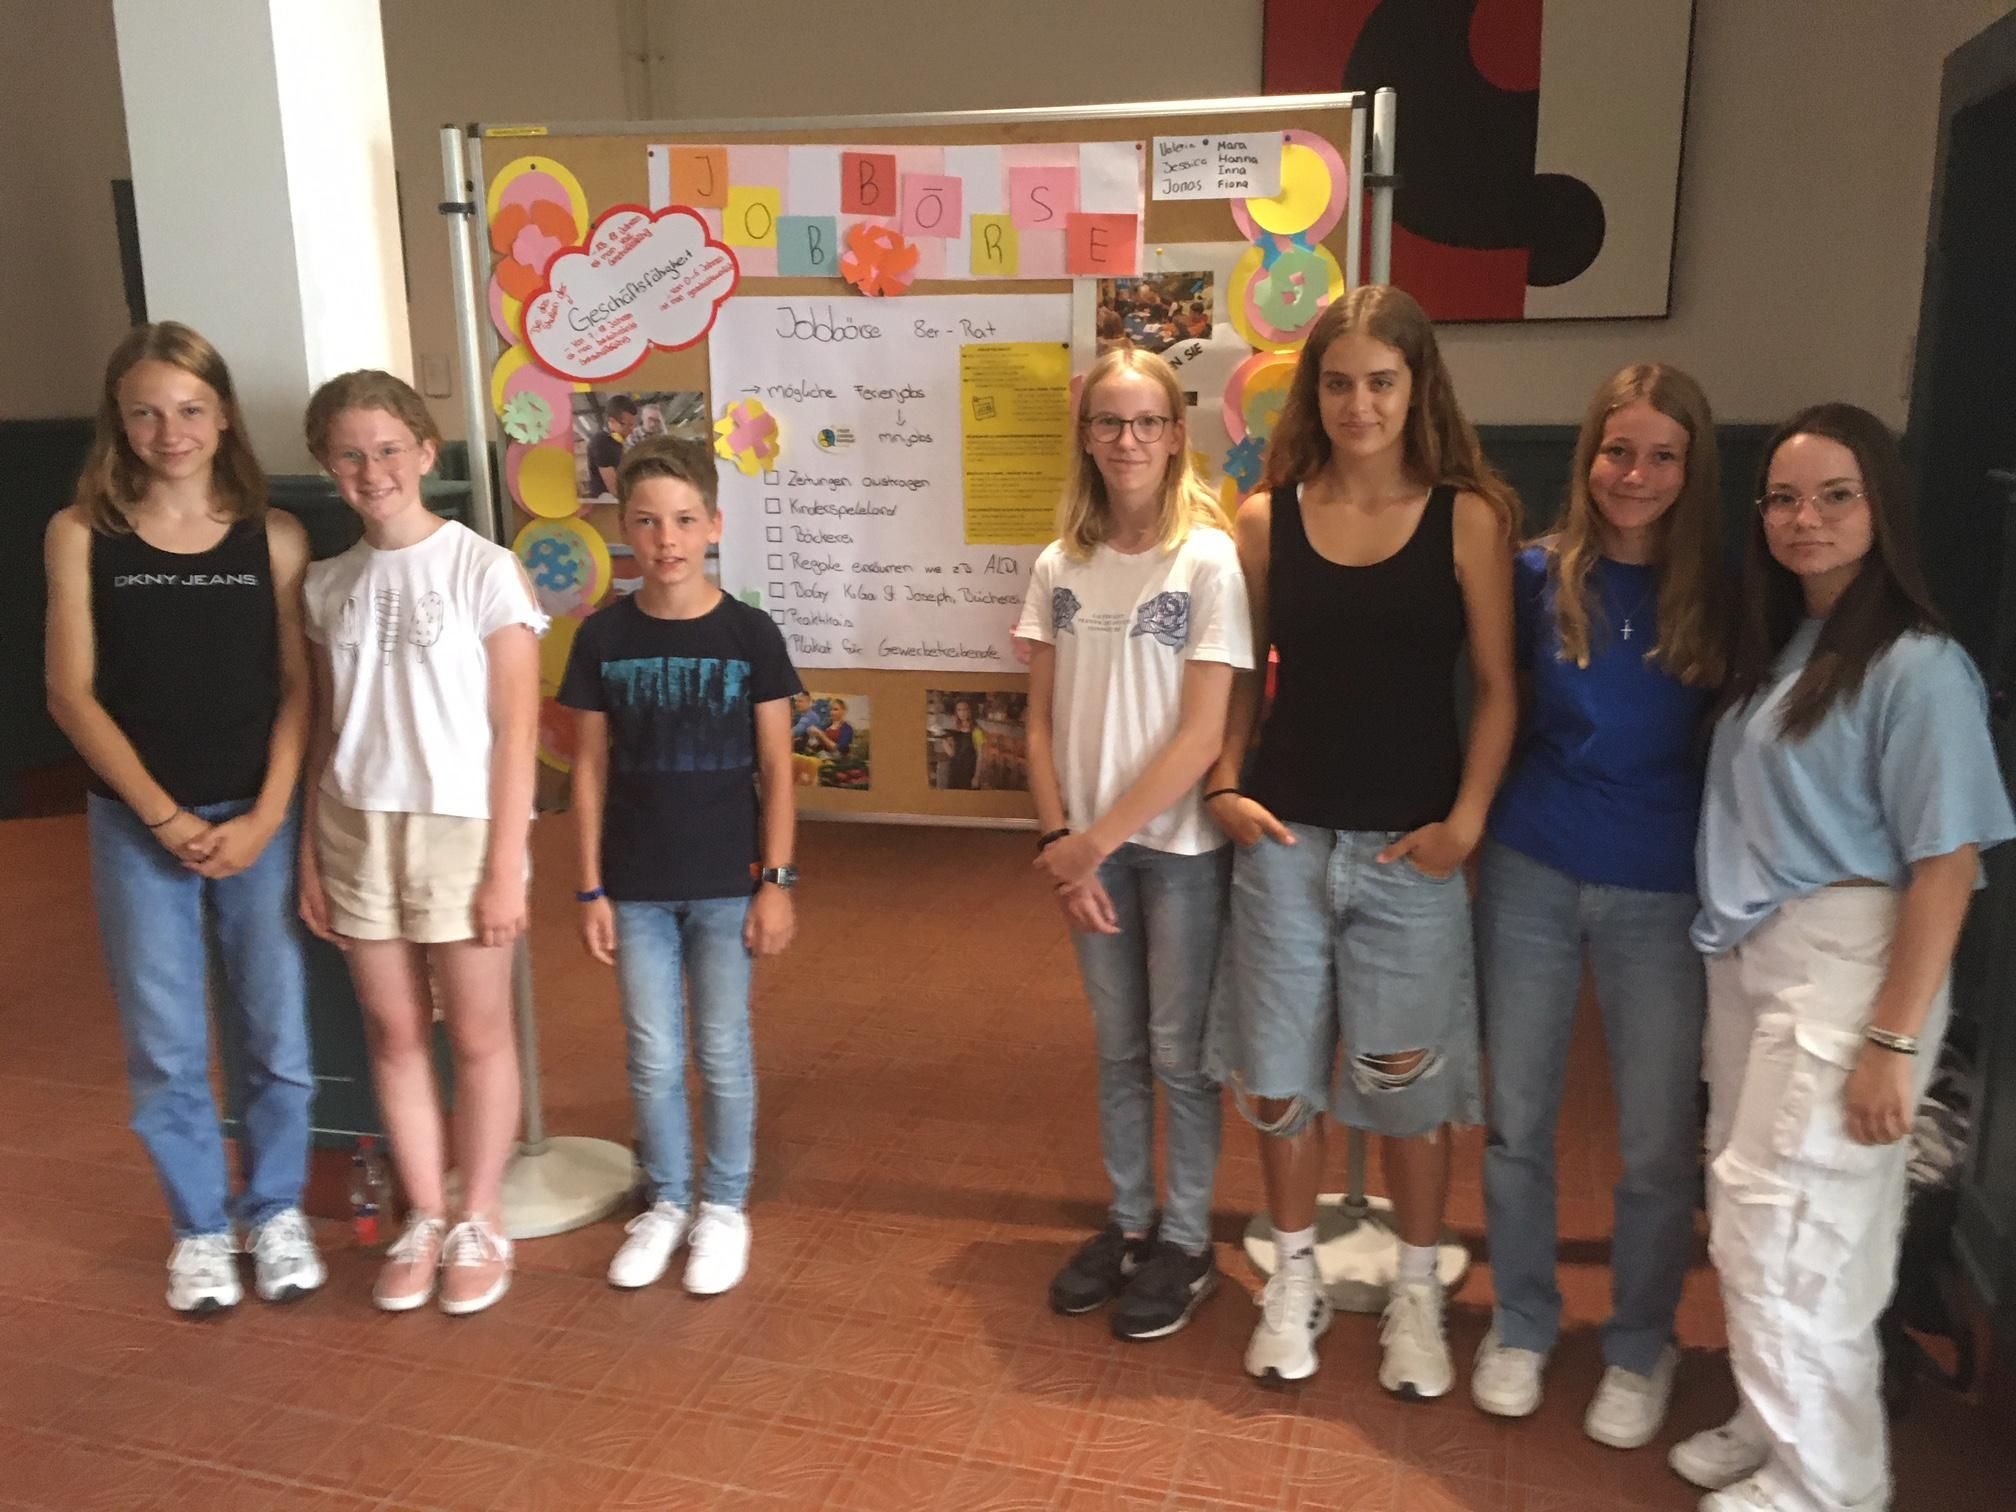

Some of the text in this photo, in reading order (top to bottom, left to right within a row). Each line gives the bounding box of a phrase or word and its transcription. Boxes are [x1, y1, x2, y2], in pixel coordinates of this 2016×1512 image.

[1217, 140, 1247, 152] Mara
[1162, 158, 1208, 174] Jessica
[1218, 153, 1259, 165] Hanna
[1218, 165, 1247, 175] Inna
[1162, 178, 1203, 195] Jonas
[1217, 179, 1249, 189] Fiona
[776, 304, 882, 342] Jobbörse
[1184, 342, 1203, 361] SIE
[767, 379, 838, 403] mögliche
[789, 552, 844, 575] Regale
[113, 573, 259, 588] DKNY JEANS
